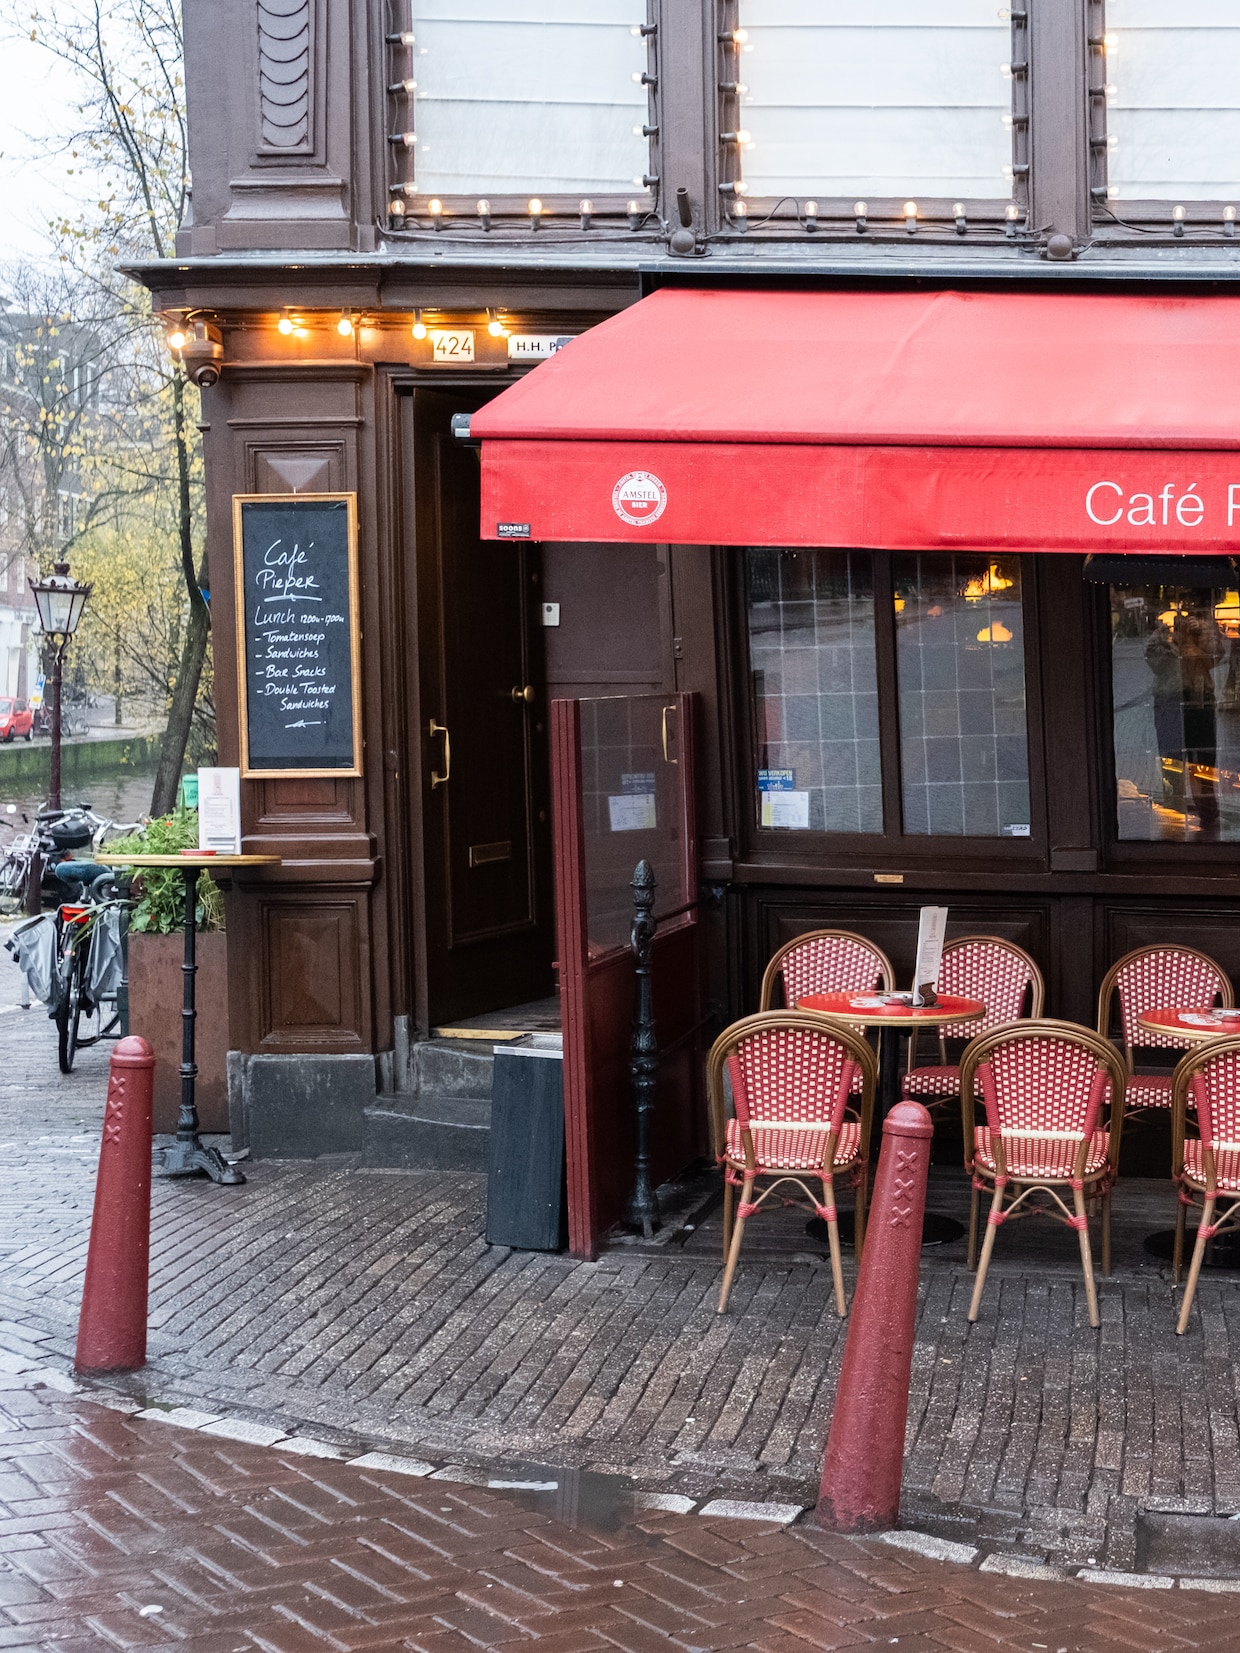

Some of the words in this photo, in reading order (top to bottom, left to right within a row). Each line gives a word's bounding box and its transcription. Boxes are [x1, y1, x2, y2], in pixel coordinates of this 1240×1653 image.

[436, 336, 472, 355] 424
[516, 341, 545, 352] H.H.
[622, 490, 657, 499] AMSTEL
[1085, 480, 1204, 527] Café
[264, 539, 315, 575] Café
[254, 606, 295, 626] Lunch
[263, 629, 326, 645] Tomatensoep
[265, 645, 320, 660] Sandwiches
[292, 664, 327, 678] Snacks
[264, 683, 299, 696] Double
[280, 698, 330, 711] Sandwiches
